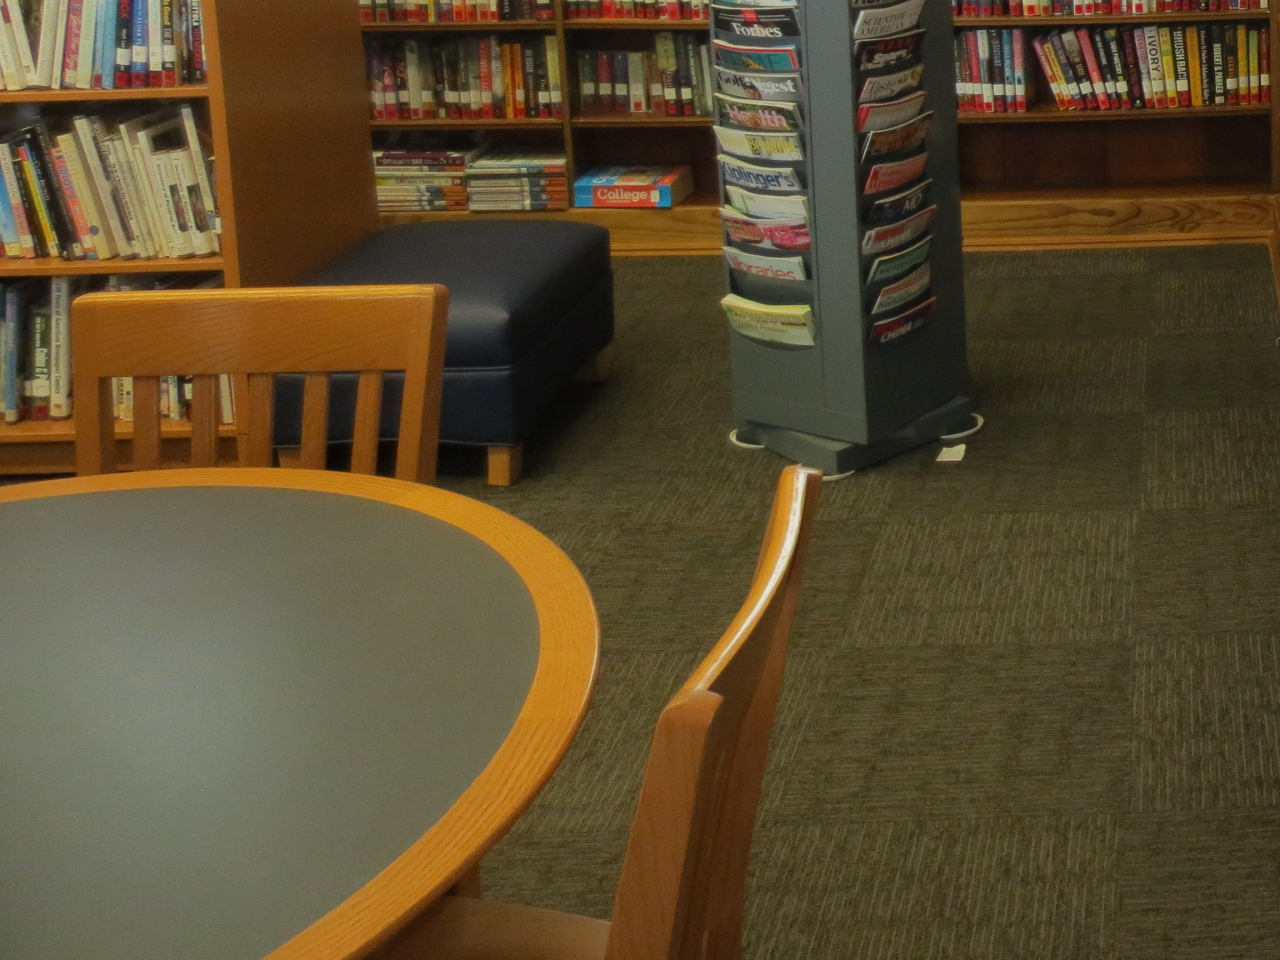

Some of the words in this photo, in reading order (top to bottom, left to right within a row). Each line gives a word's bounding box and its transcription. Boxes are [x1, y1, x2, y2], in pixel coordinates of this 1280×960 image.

[162, 5, 171, 26] Good
[731, 20, 783, 38] Forbes
[1109, 41, 1119, 53] SARA
[1146, 34, 1160, 73] IVORY
[1212, 43, 1222, 66] ROBERT
[1111, 53, 1122, 75] PARETSKY
[1213, 72, 1224, 94] PARKER
[720, 161, 796, 189] Kiplinger's
[596, 187, 648, 201] College
[879, 320, 913, 343] CHINA
[35, 347, 49, 373] Coins
